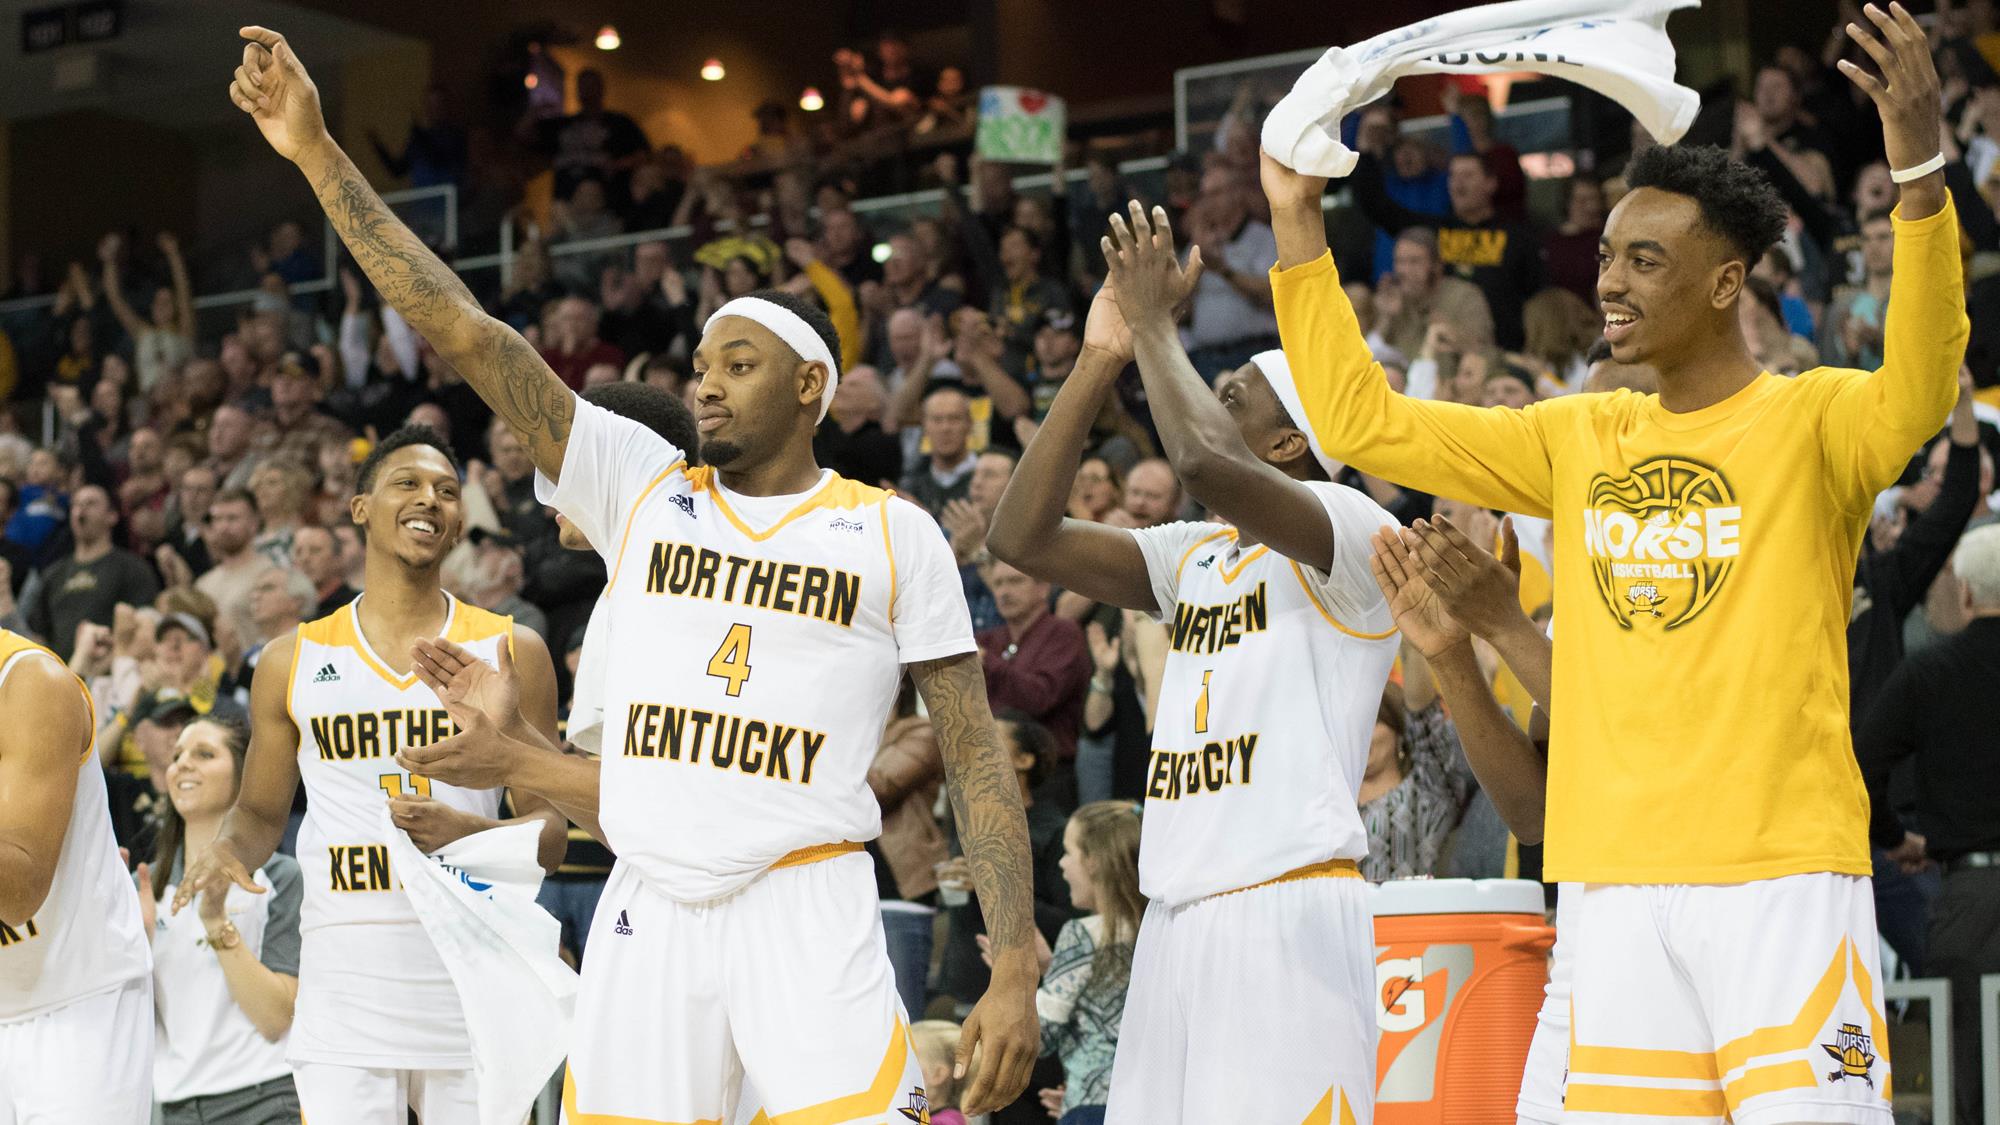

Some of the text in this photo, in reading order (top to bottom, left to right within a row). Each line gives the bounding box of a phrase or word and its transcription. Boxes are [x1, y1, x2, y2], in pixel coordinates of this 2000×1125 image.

[1583, 506, 1742, 561] NORSE
[645, 540, 862, 629] NORTHERN
[706, 622, 753, 698] 4
[309, 708, 463, 761] NORTHE
[1194, 669, 1214, 734] 1
[623, 702, 828, 786] KENTUCKY
[328, 843, 405, 893] KEN
[1375, 956, 1426, 1033] G
